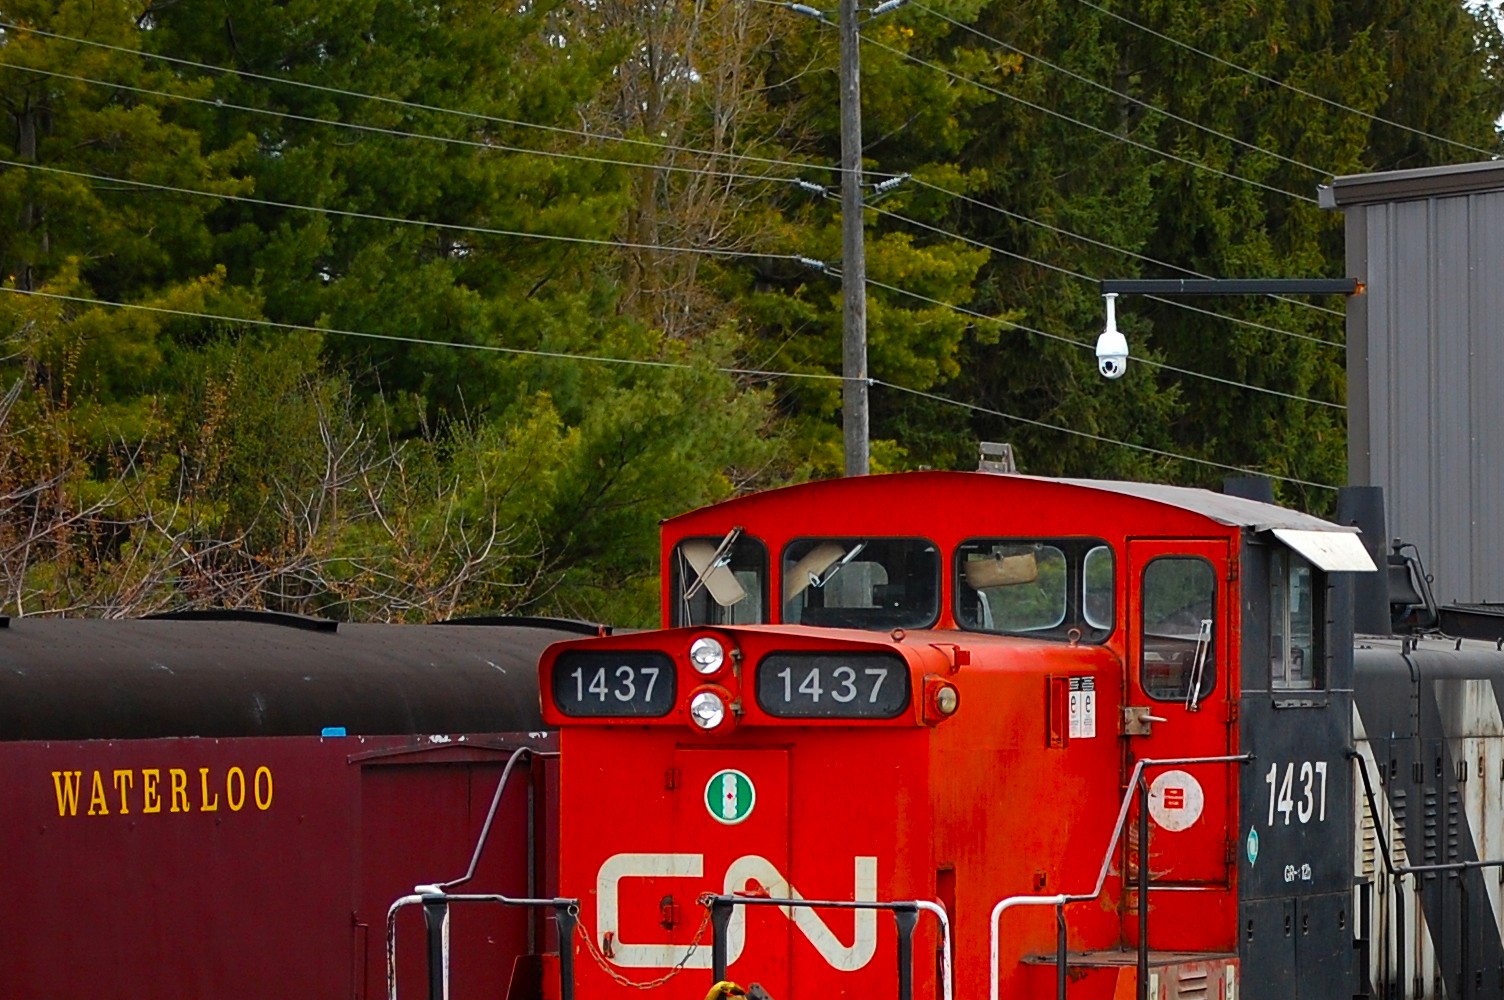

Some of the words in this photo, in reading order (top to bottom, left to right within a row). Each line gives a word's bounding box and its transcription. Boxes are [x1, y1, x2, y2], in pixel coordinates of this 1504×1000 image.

[571, 666, 660, 702] 1437
[777, 666, 888, 703] 1437
[52, 766, 273, 817] WATERLOO
[1265, 761, 1328, 826] 1437
[597, 853, 877, 971] CN
